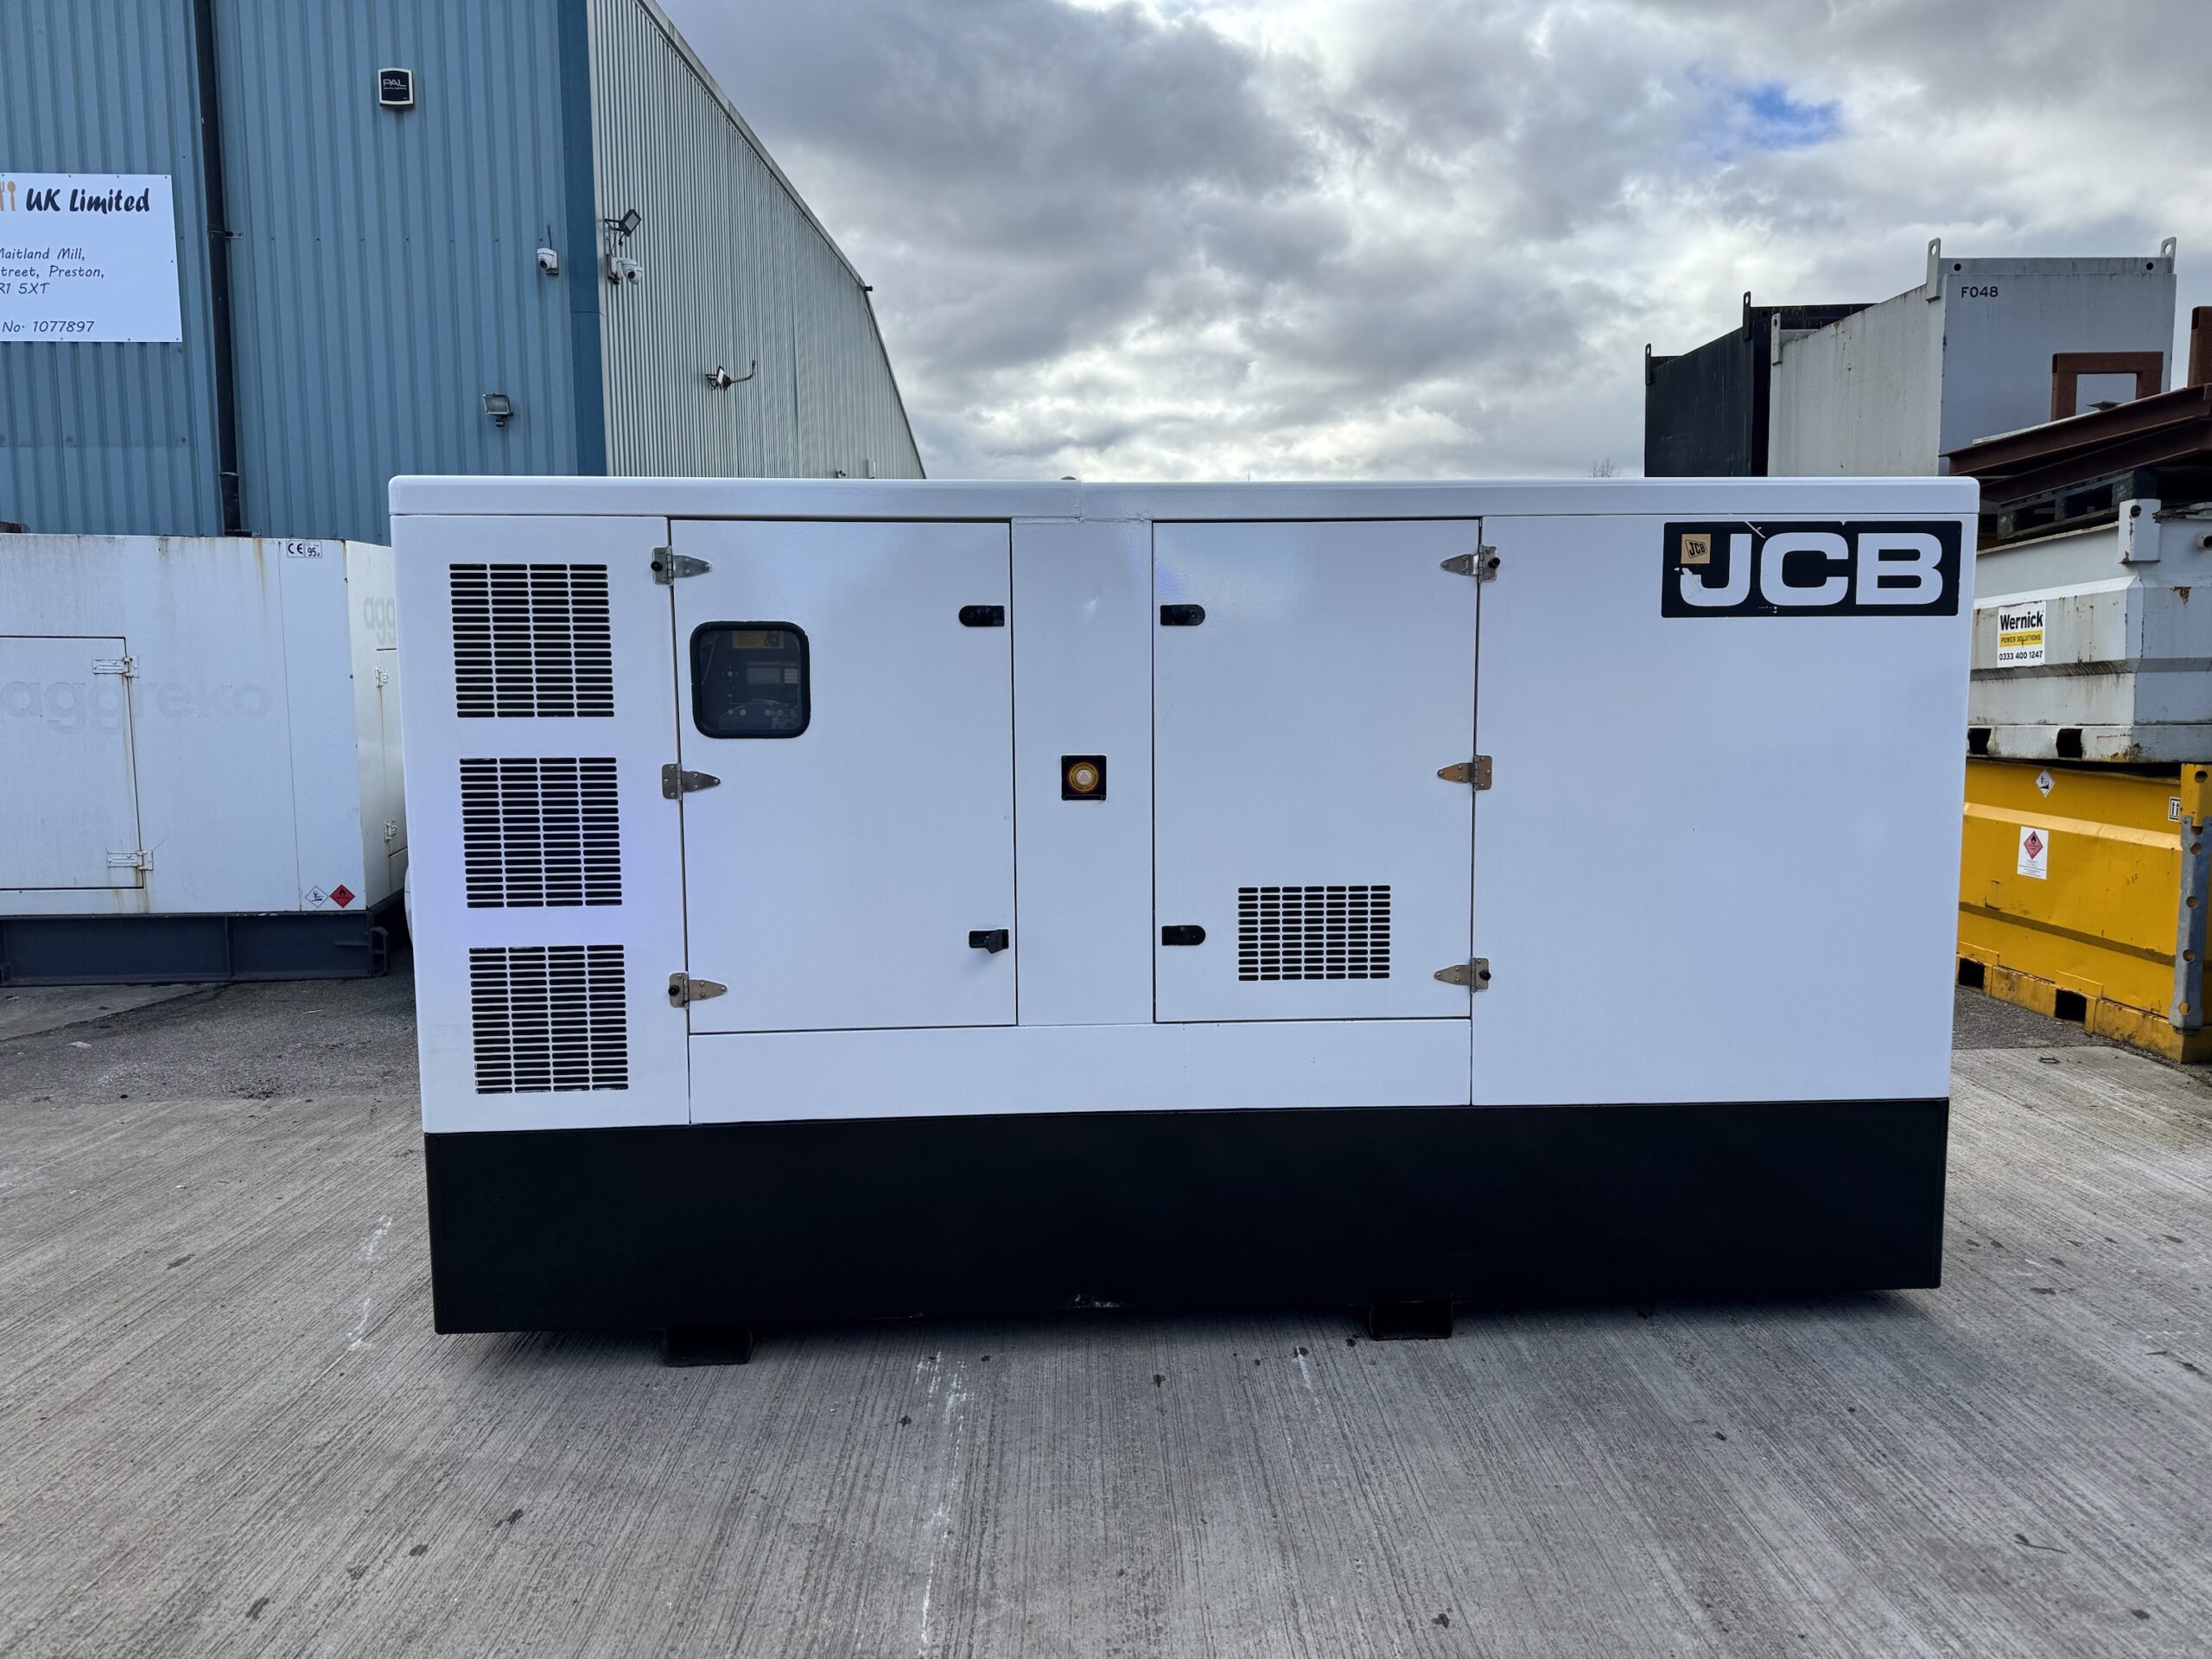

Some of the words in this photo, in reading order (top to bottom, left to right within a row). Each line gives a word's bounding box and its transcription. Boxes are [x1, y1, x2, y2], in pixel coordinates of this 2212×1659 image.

[383, 79, 407, 87] PAL
[26, 188, 60, 212] UK
[69, 188, 150, 214] Limited
[57, 247, 85, 261] Mill,
[48, 264, 104, 278] Preston,
[18, 283, 50, 294] 5XT
[1961, 286, 1999, 298] F048
[33, 321, 95, 332] 1077897
[307, 547, 317, 556] 95
[1688, 541, 1706, 556] JCB
[1680, 532, 1943, 607] JCB
[1999, 610, 2044, 631] Wernick
[2017, 633, 2042, 643] SOLUTIONS
[1999, 652, 2014, 661] 0333
[2029, 650, 2044, 659] 1247
